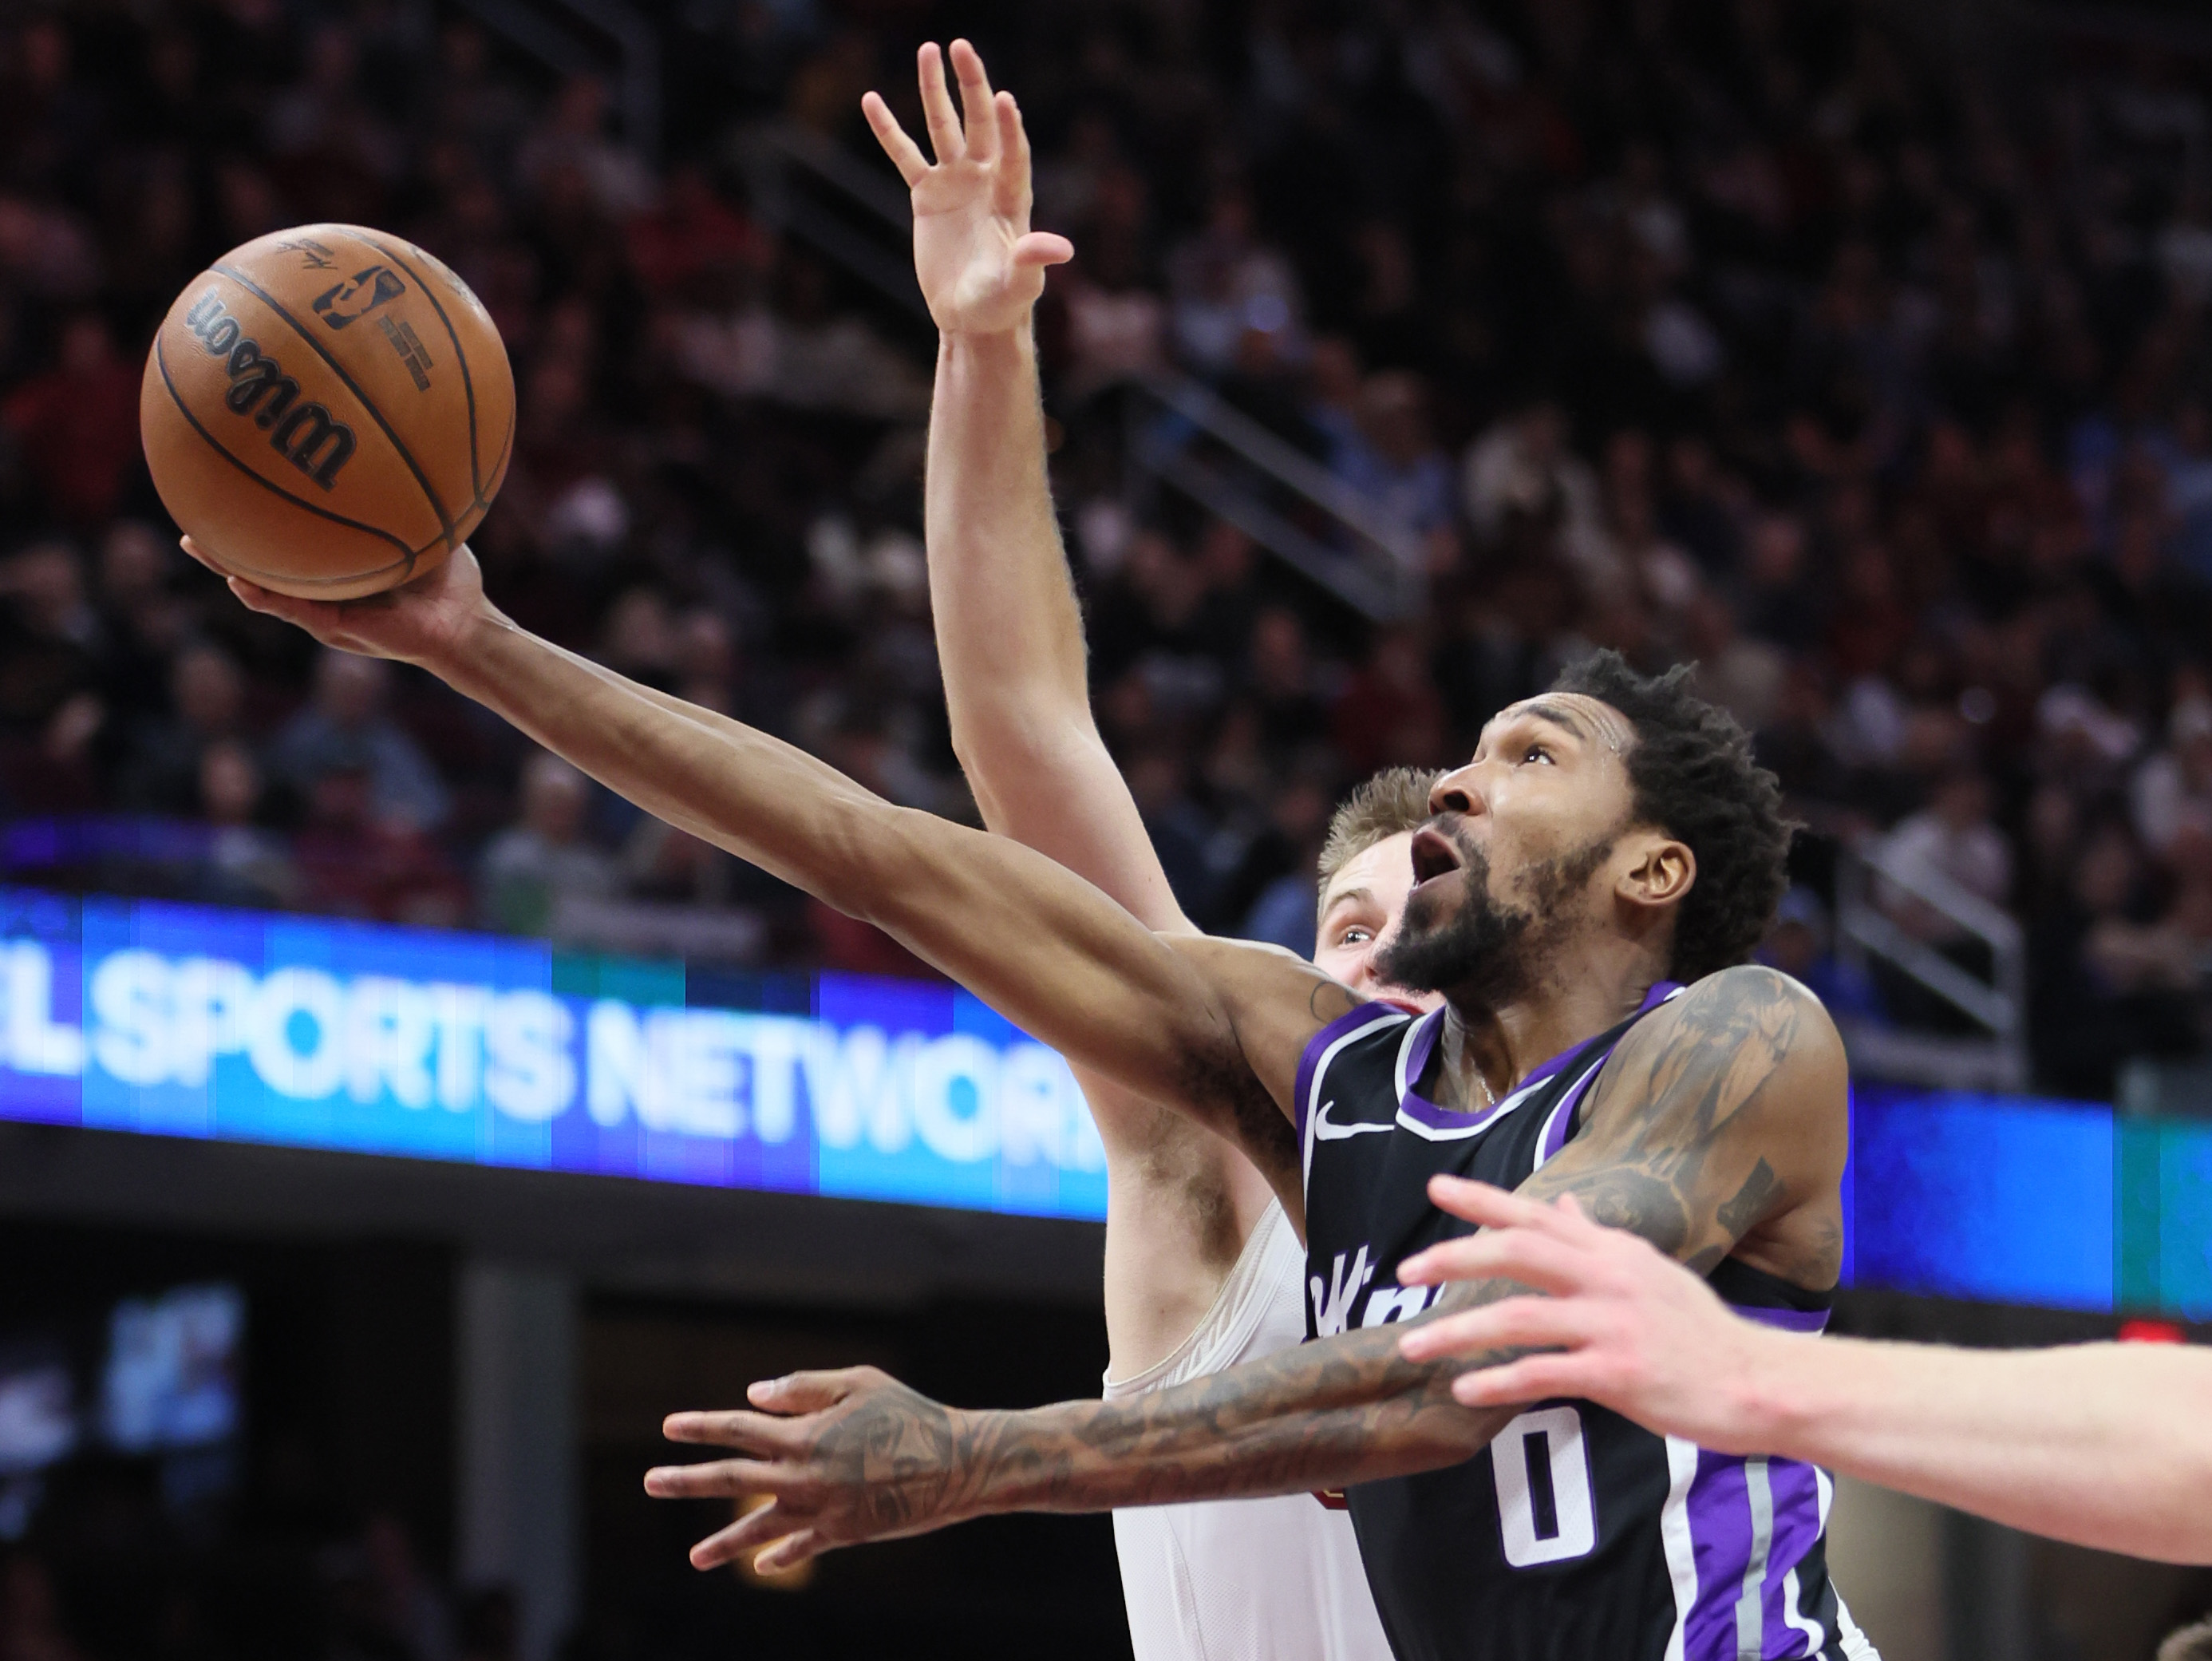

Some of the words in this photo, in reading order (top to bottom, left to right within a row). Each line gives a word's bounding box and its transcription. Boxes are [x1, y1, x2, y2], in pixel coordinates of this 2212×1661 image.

[187, 285, 357, 493] Wilson
[90, 946, 578, 1123] SPORTS
[1490, 1405, 1596, 1568] 0
